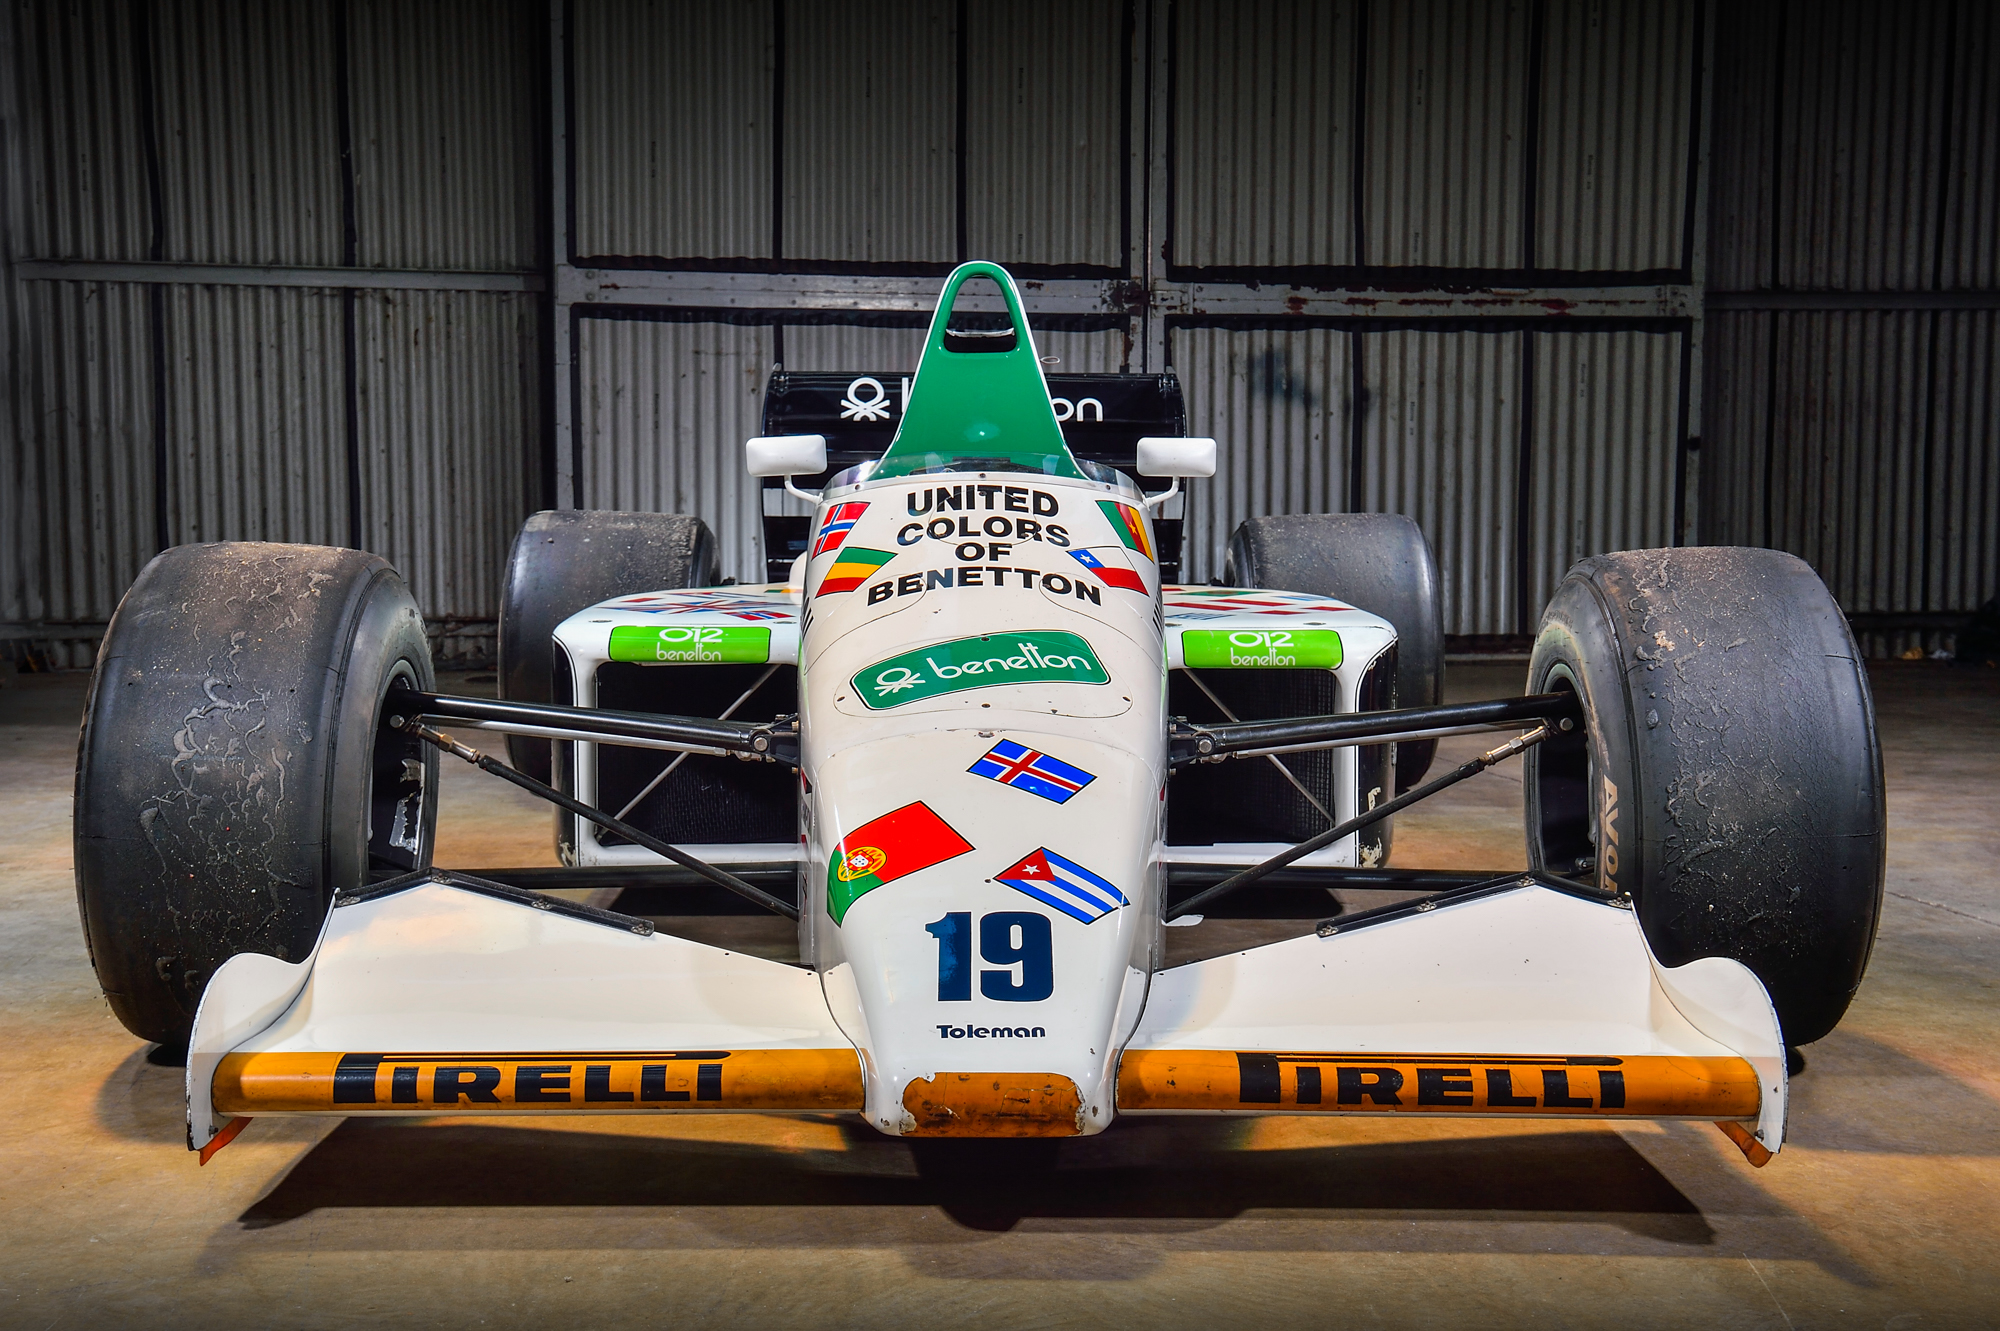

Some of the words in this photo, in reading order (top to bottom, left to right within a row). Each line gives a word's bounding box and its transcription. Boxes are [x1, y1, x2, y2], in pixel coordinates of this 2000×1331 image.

[907, 485, 1059, 518] UNITED
[897, 515, 1071, 547] COLORS
[955, 542, 1012, 561] OF
[867, 566, 1101, 606] BENETTON
[656, 642, 721, 662] benetton
[926, 642, 1091, 680] benetton
[1230, 647, 1295, 666] benetton
[925, 911, 1054, 1002] 19
[936, 1024, 1046, 1038] Toleman
[333, 1052, 731, 1104] PIRELLI
[1236, 1052, 1623, 1109] PIRELLI
